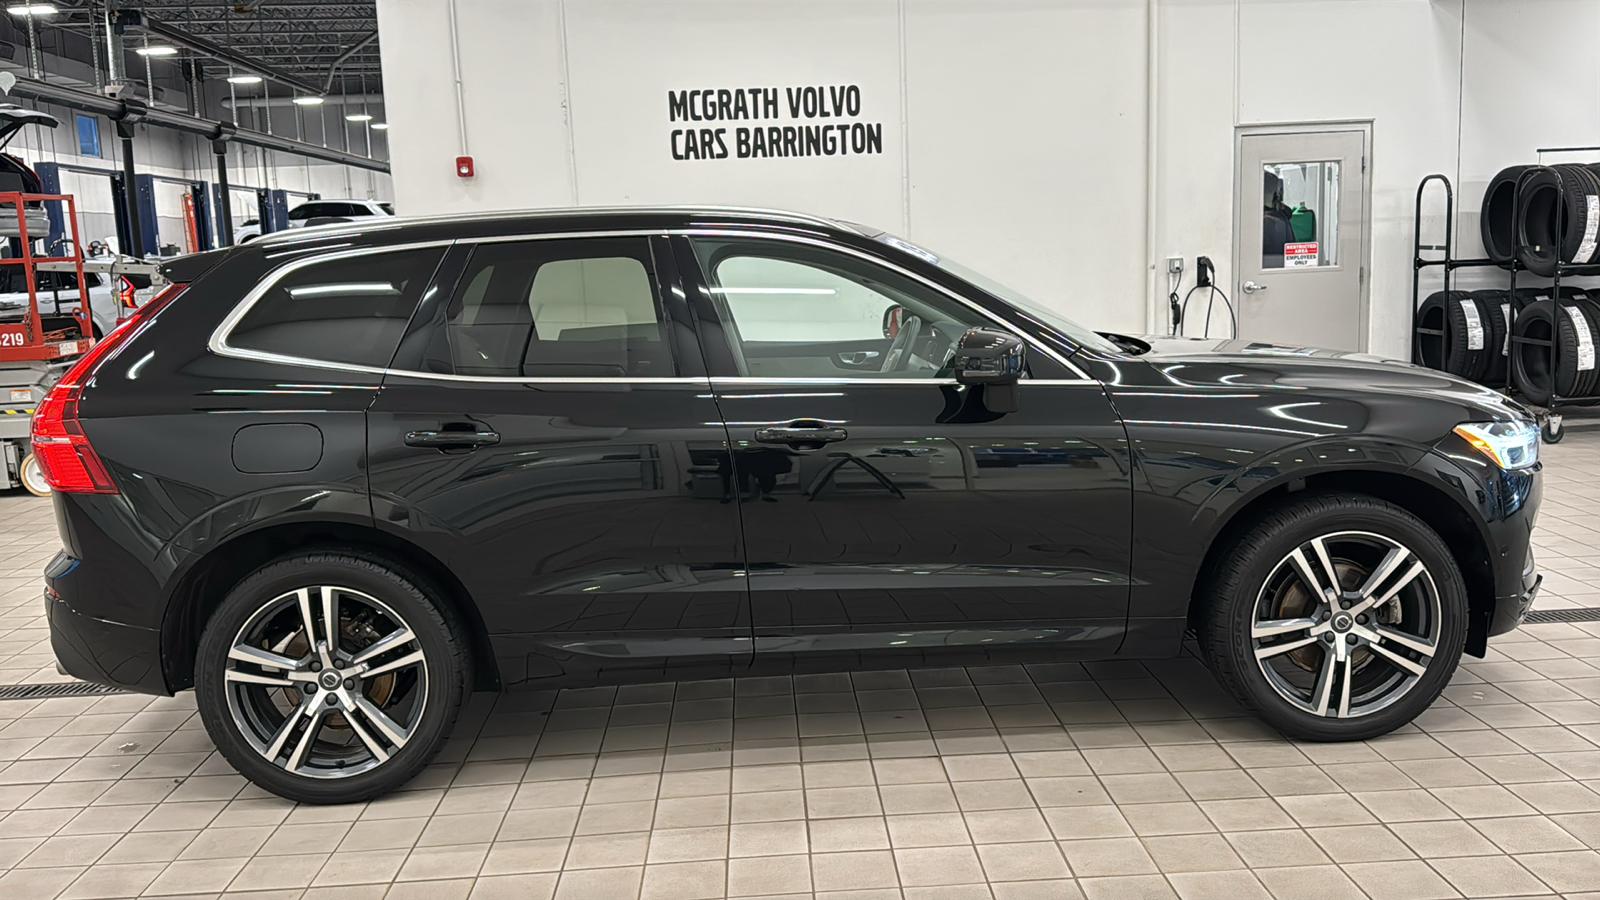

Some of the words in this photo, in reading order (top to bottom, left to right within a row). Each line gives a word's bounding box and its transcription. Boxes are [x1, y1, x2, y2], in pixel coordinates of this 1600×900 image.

[668, 88, 779, 122] MCGRATH
[786, 84, 861, 119] VOLVO
[670, 128, 729, 161] CARS
[736, 122, 883, 159] BARRINGTON
[0, 332, 24, 347] 219
